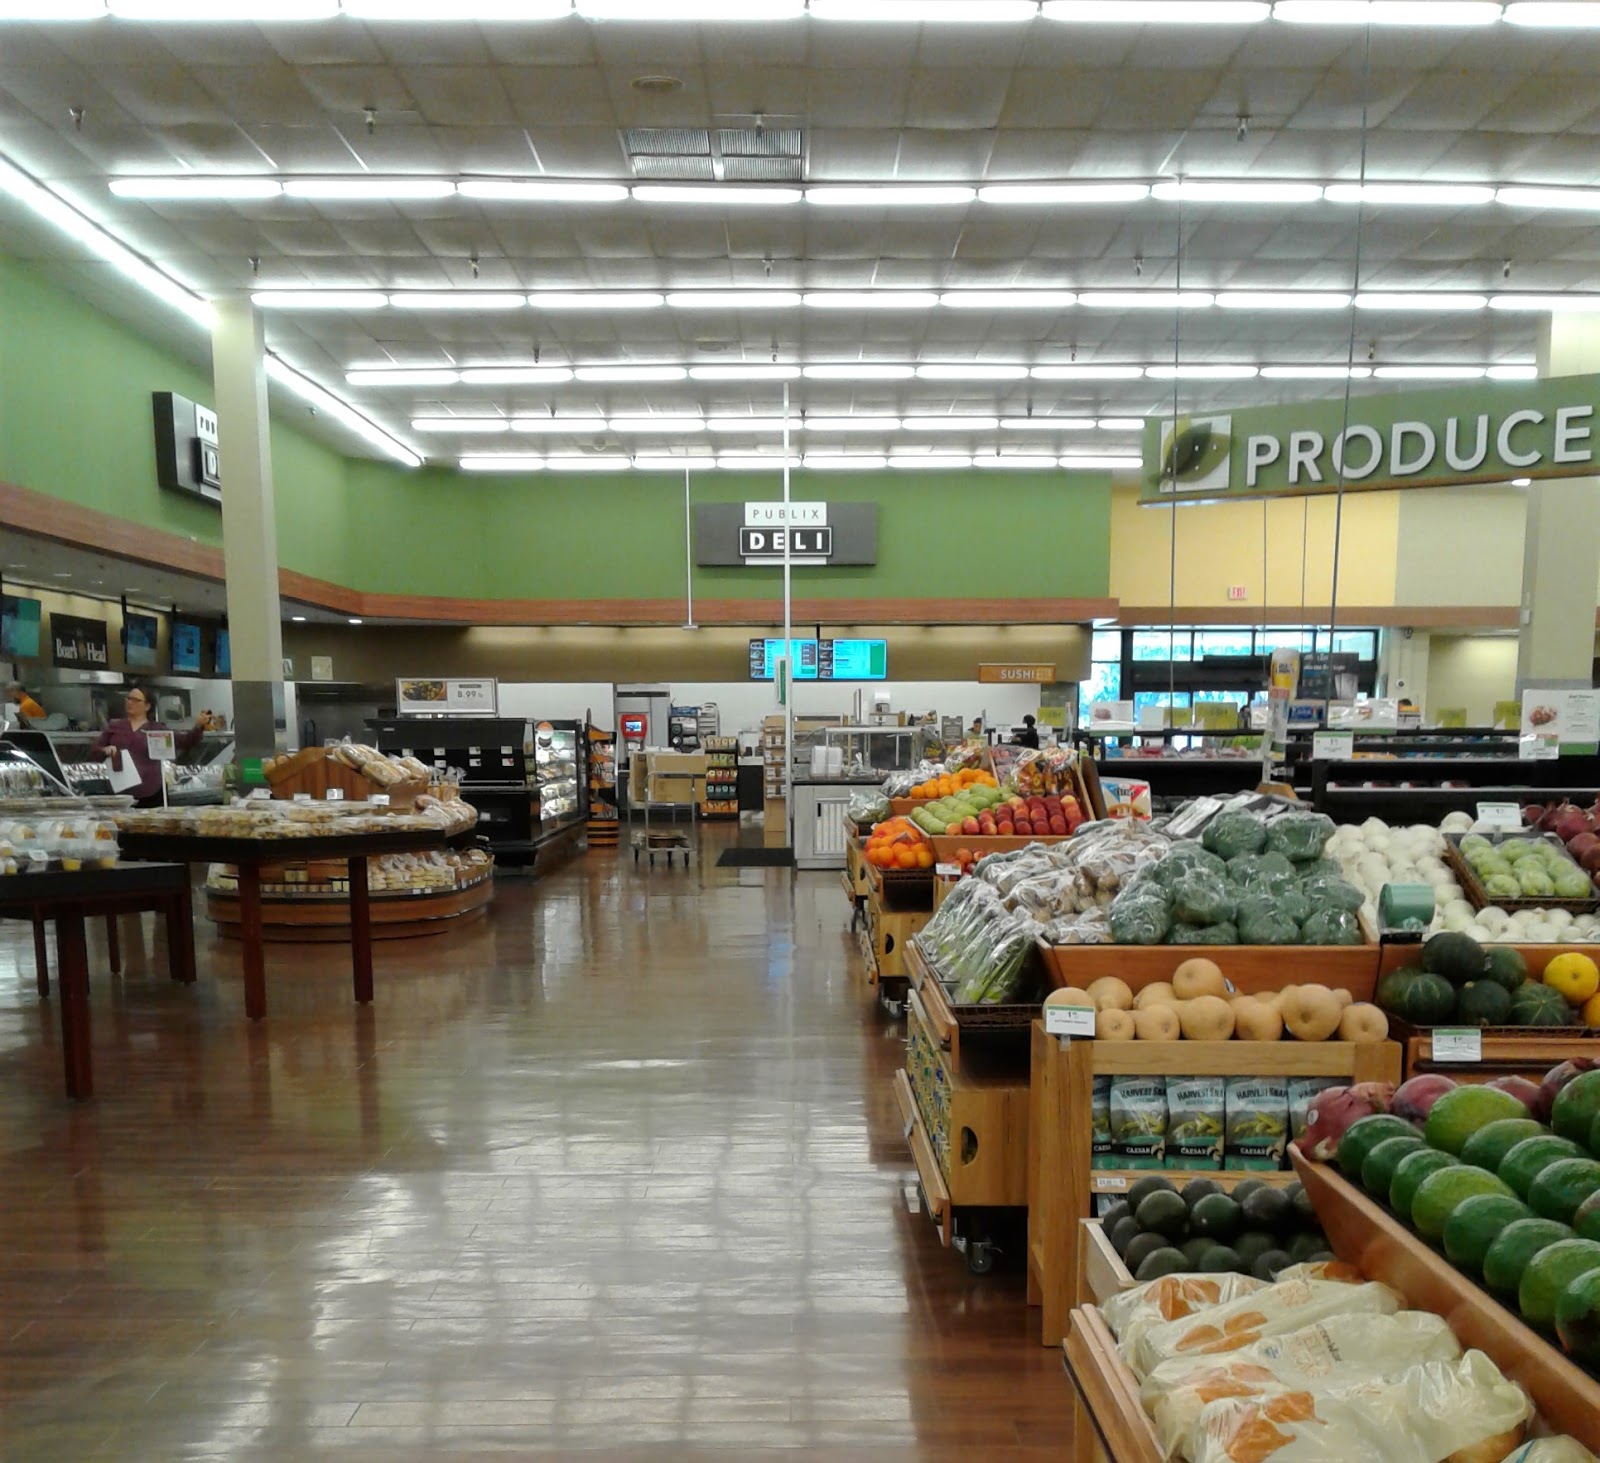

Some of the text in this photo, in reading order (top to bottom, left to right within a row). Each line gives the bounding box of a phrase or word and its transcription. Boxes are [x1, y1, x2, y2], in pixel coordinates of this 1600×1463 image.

[200, 416, 215, 434] PUB
[1246, 405, 1594, 488] PRODUCE
[753, 509, 819, 519] PUBLIX
[749, 532, 822, 550] DELI
[87, 643, 106, 663] Head
[1001, 669, 1034, 679] SUSHI
[457, 691, 476, 699] 8.99
[1120, 1087, 1152, 1099] HARVEST
[1177, 1088, 1208, 1101] HARVEST
[1126, 1146, 1150, 1154] CAESAR
[1181, 1147, 1207, 1155] CAESAR
[1240, 1147, 1266, 1155] CAESAR
